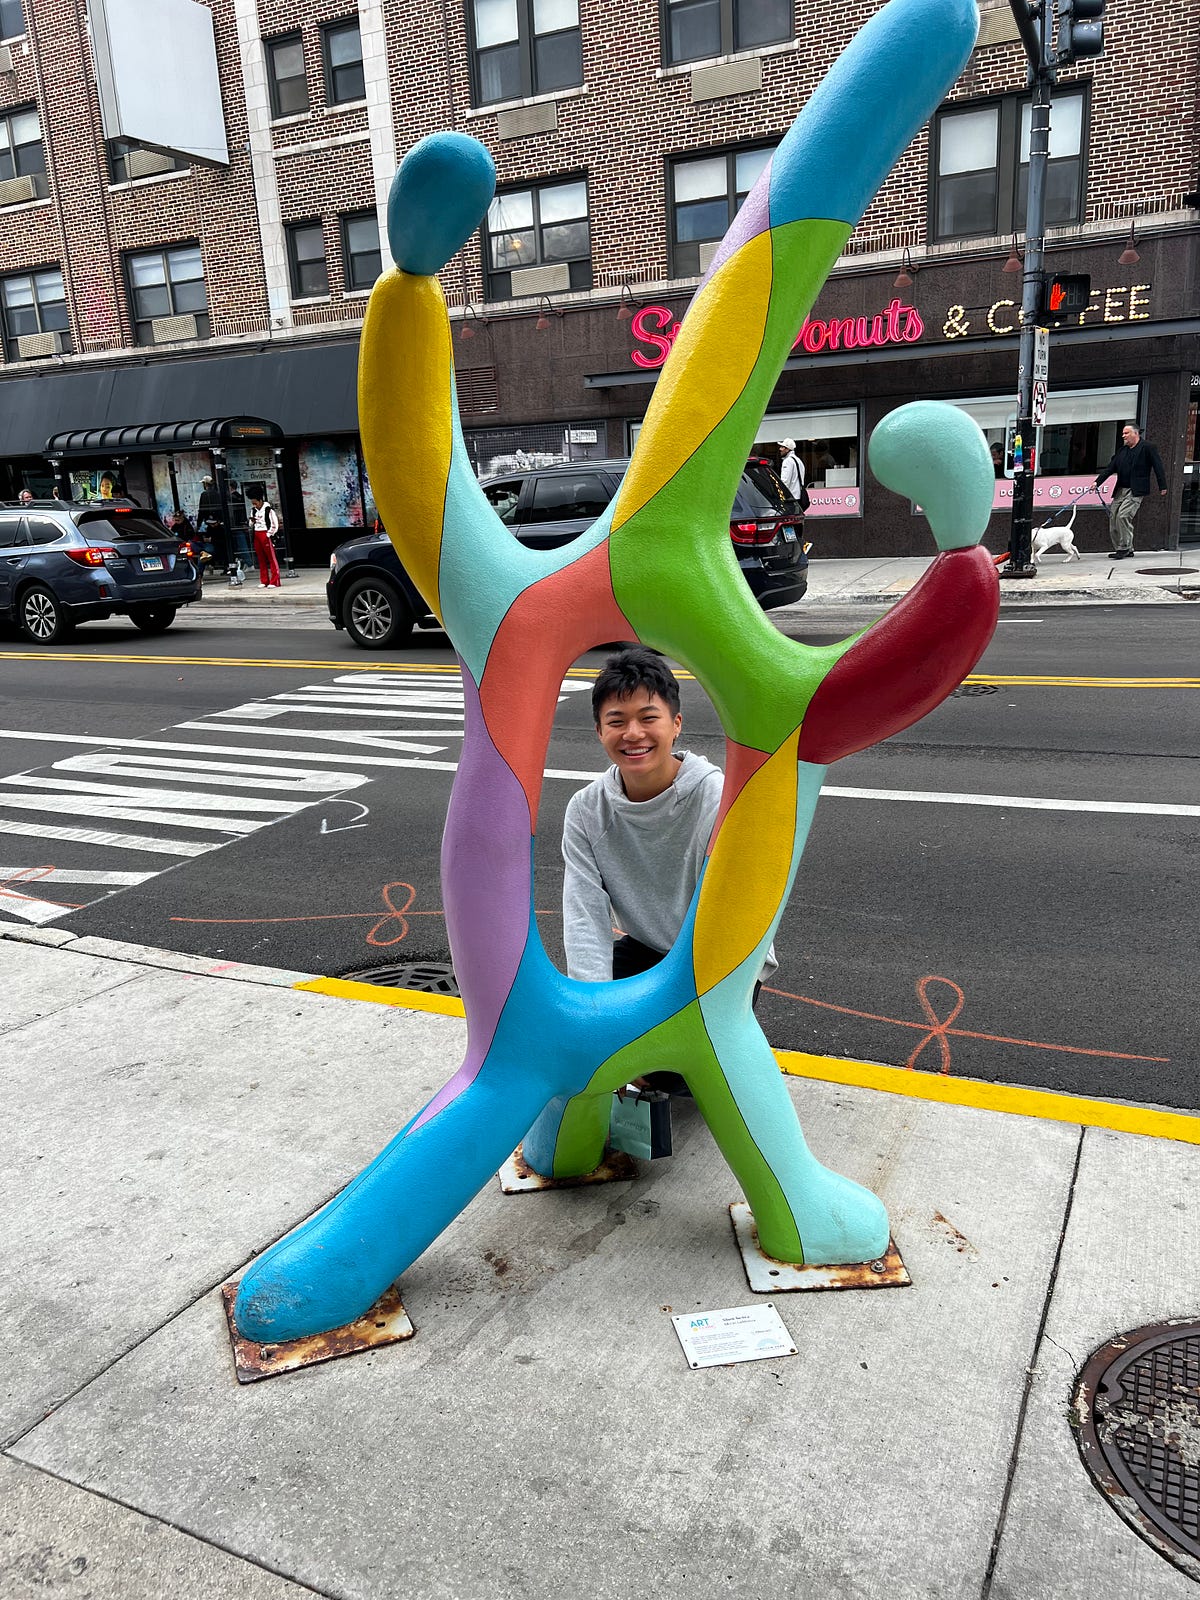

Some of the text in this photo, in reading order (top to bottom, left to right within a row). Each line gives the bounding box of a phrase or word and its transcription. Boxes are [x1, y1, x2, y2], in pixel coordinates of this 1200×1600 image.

[791, 298, 924, 353] onuts
[943, 305, 969, 338] &
[809, 496, 843, 506] ONUTS
[690, 1318, 709, 1328] ART
